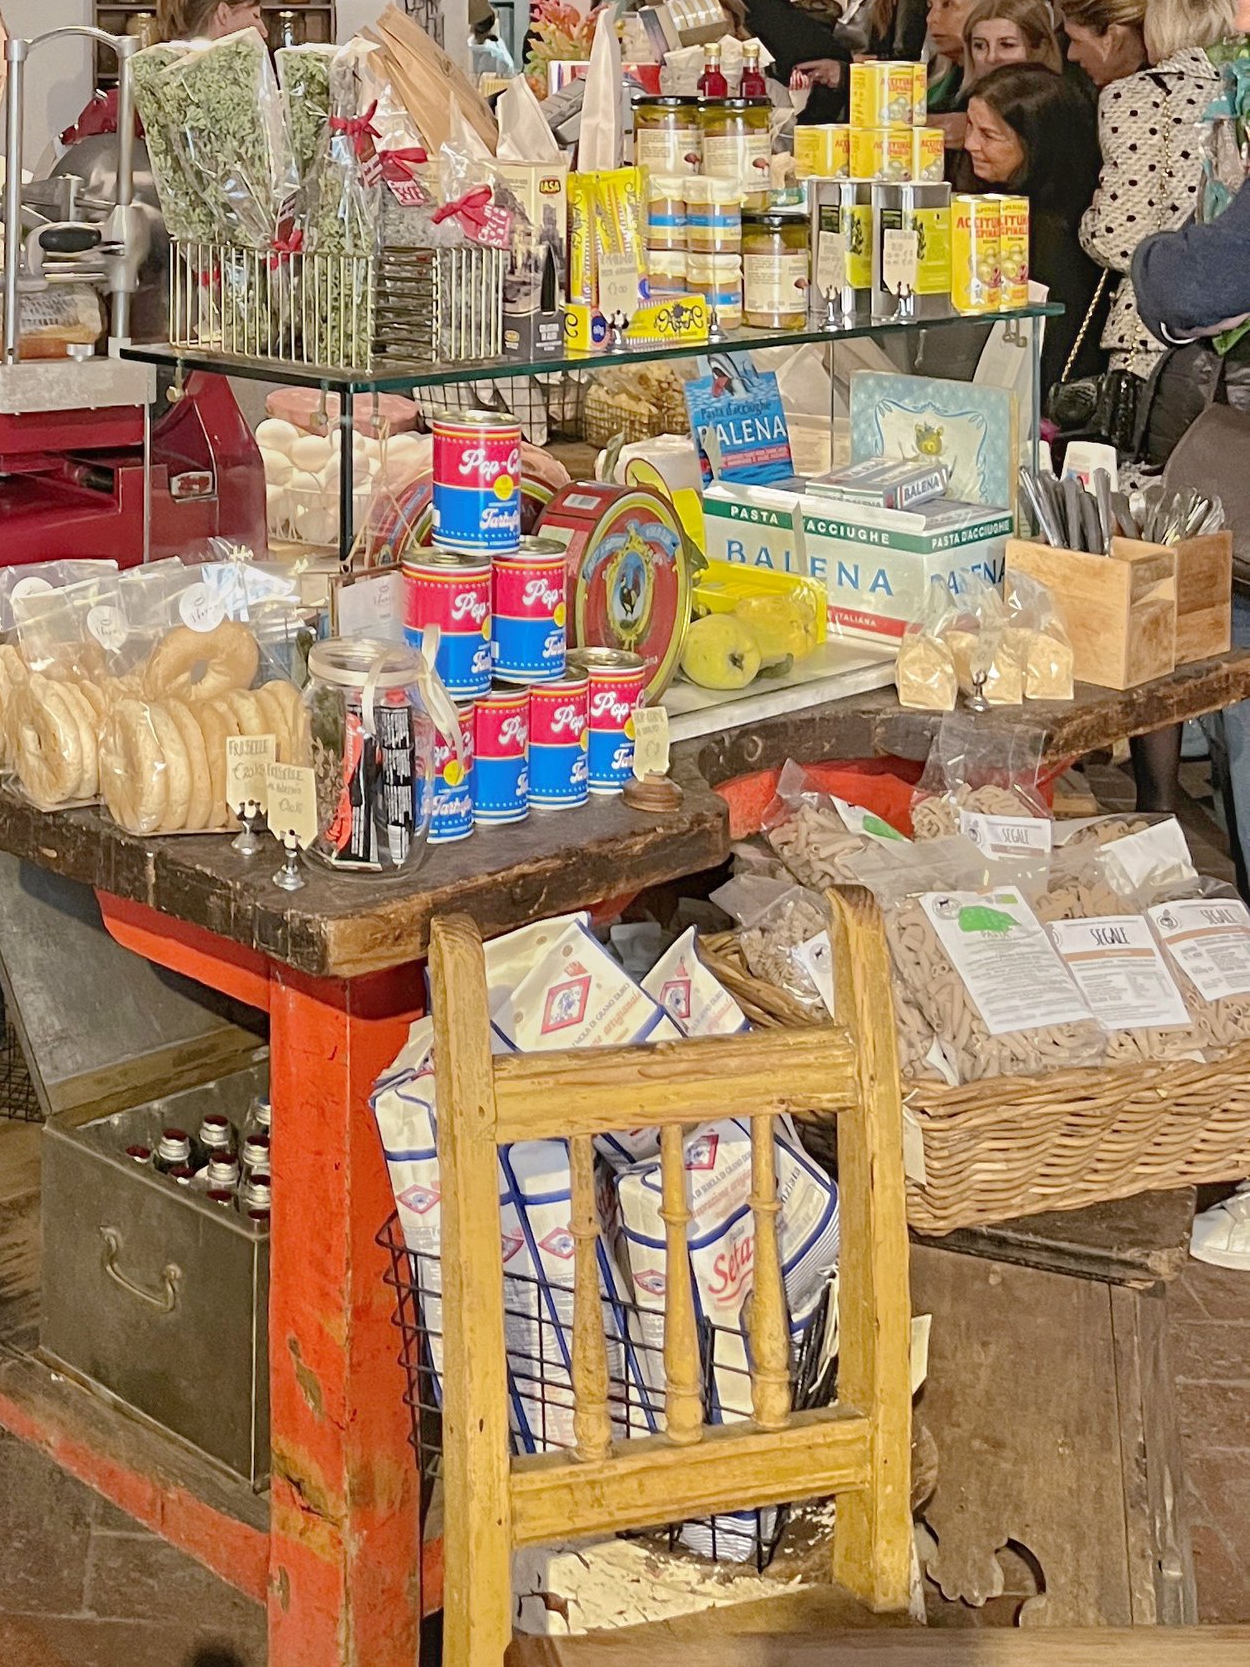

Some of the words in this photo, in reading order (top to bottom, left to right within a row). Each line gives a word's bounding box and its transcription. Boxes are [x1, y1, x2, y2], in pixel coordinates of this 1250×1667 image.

[540, 181, 561, 193] IASA
[903, 472, 940, 503] BALENA
[730, 505, 779, 525] PASTA
[802, 517, 891, 545] 'ACCIUGHE
[931, 534, 960, 550] PASTA
[726, 540, 894, 597] BALENA
[590, 689, 645, 723] Pop-C
[1090, 926, 1131, 946] SEGALE
[708, 1236, 754, 1294] Seta
